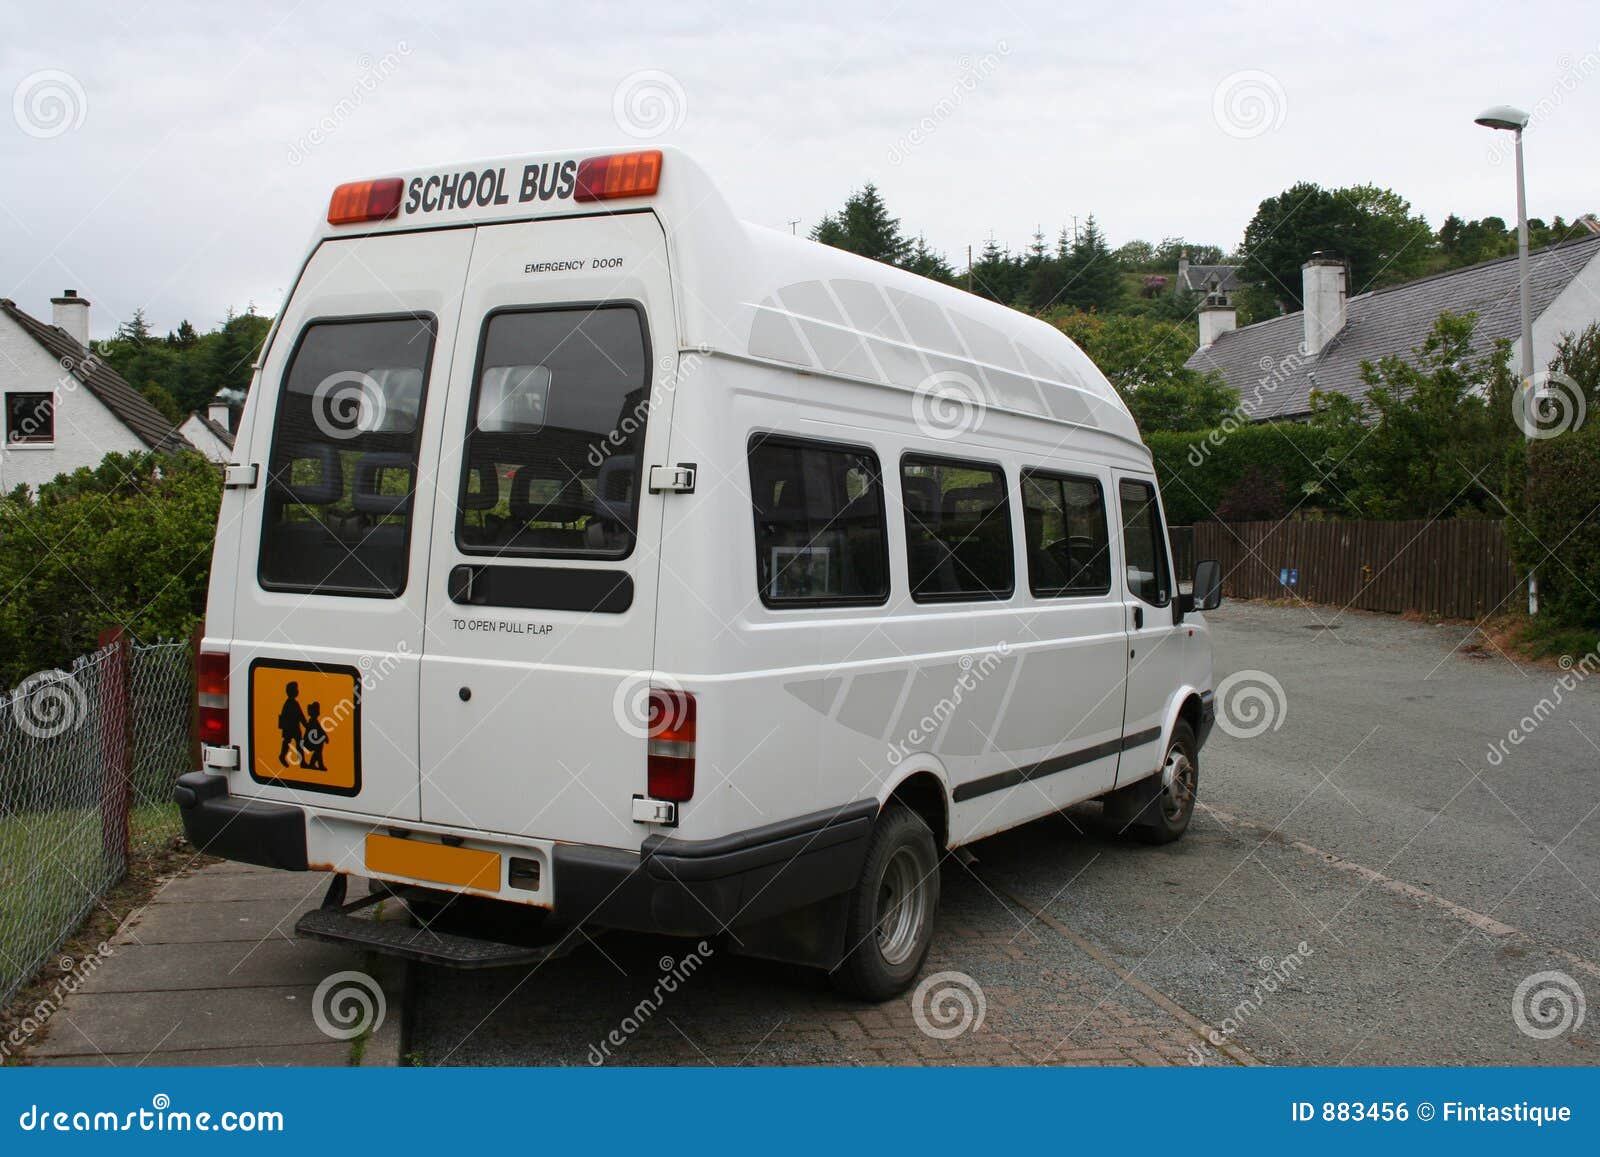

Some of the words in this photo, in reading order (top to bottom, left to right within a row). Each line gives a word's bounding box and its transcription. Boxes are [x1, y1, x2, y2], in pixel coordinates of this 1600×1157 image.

[405, 168, 509, 214] SCHOOL
[519, 160, 577, 202] BUS
[524, 260, 585, 273] EMERGENCY
[592, 258, 623, 268] DOOR
[452, 619, 466, 630] TO
[468, 620, 496, 632] OPEN
[499, 622, 524, 633] PULL
[527, 624, 553, 635] FLAP
